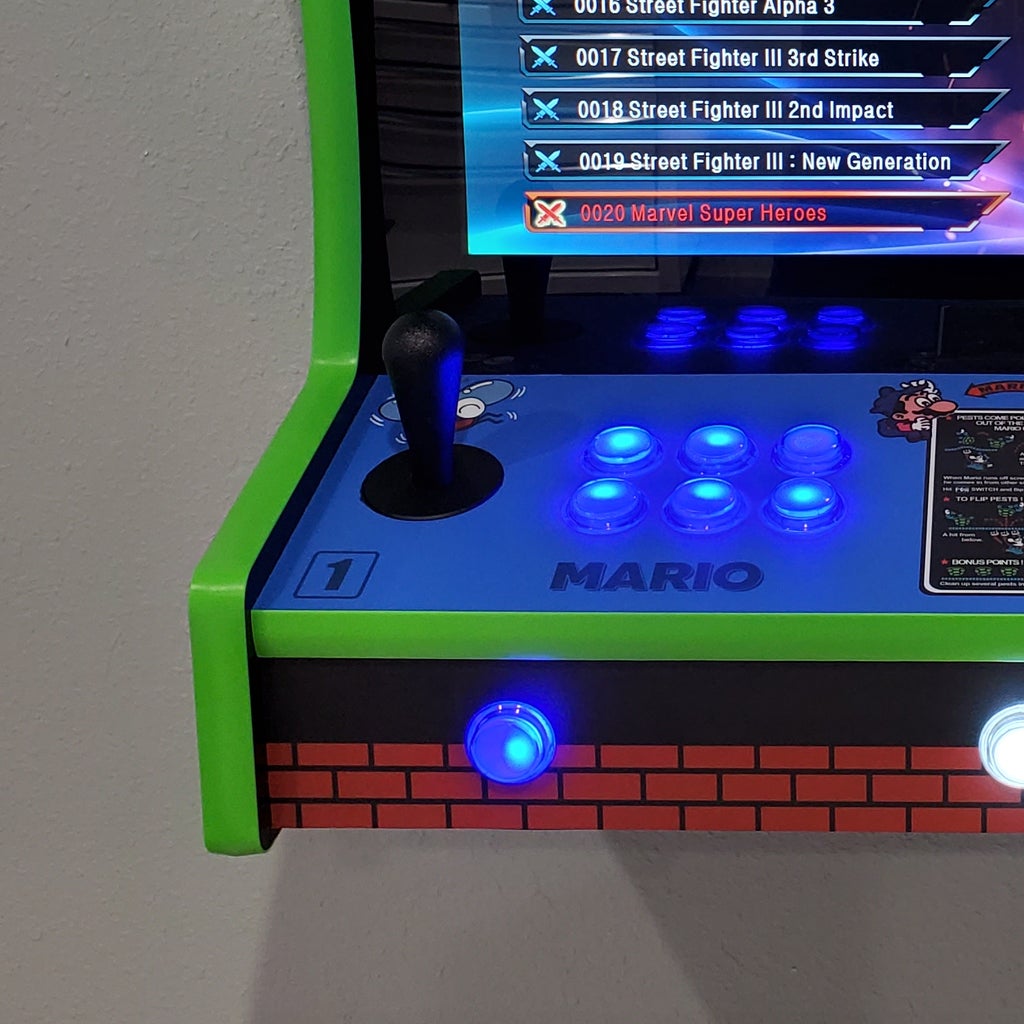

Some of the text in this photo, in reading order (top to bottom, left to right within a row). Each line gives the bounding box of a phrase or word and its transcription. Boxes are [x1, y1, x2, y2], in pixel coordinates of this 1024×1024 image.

[575, 48, 880, 72] 0017 Street Fighter III 3rd Strike
[577, 100, 894, 124] 0018 Street Fighter III 2nd Impact
[578, 152, 625, 171] 0019
[630, 152, 688, 171] Street
[693, 152, 761, 176] Fighter
[766, 152, 784, 171] III
[802, 152, 841, 171] New
[847, 152, 951, 171] Generation
[580, 204, 827, 226] 0020 Marvel Super Heroes
[325, 558, 356, 591] 1
[549, 561, 764, 592] MARIO
